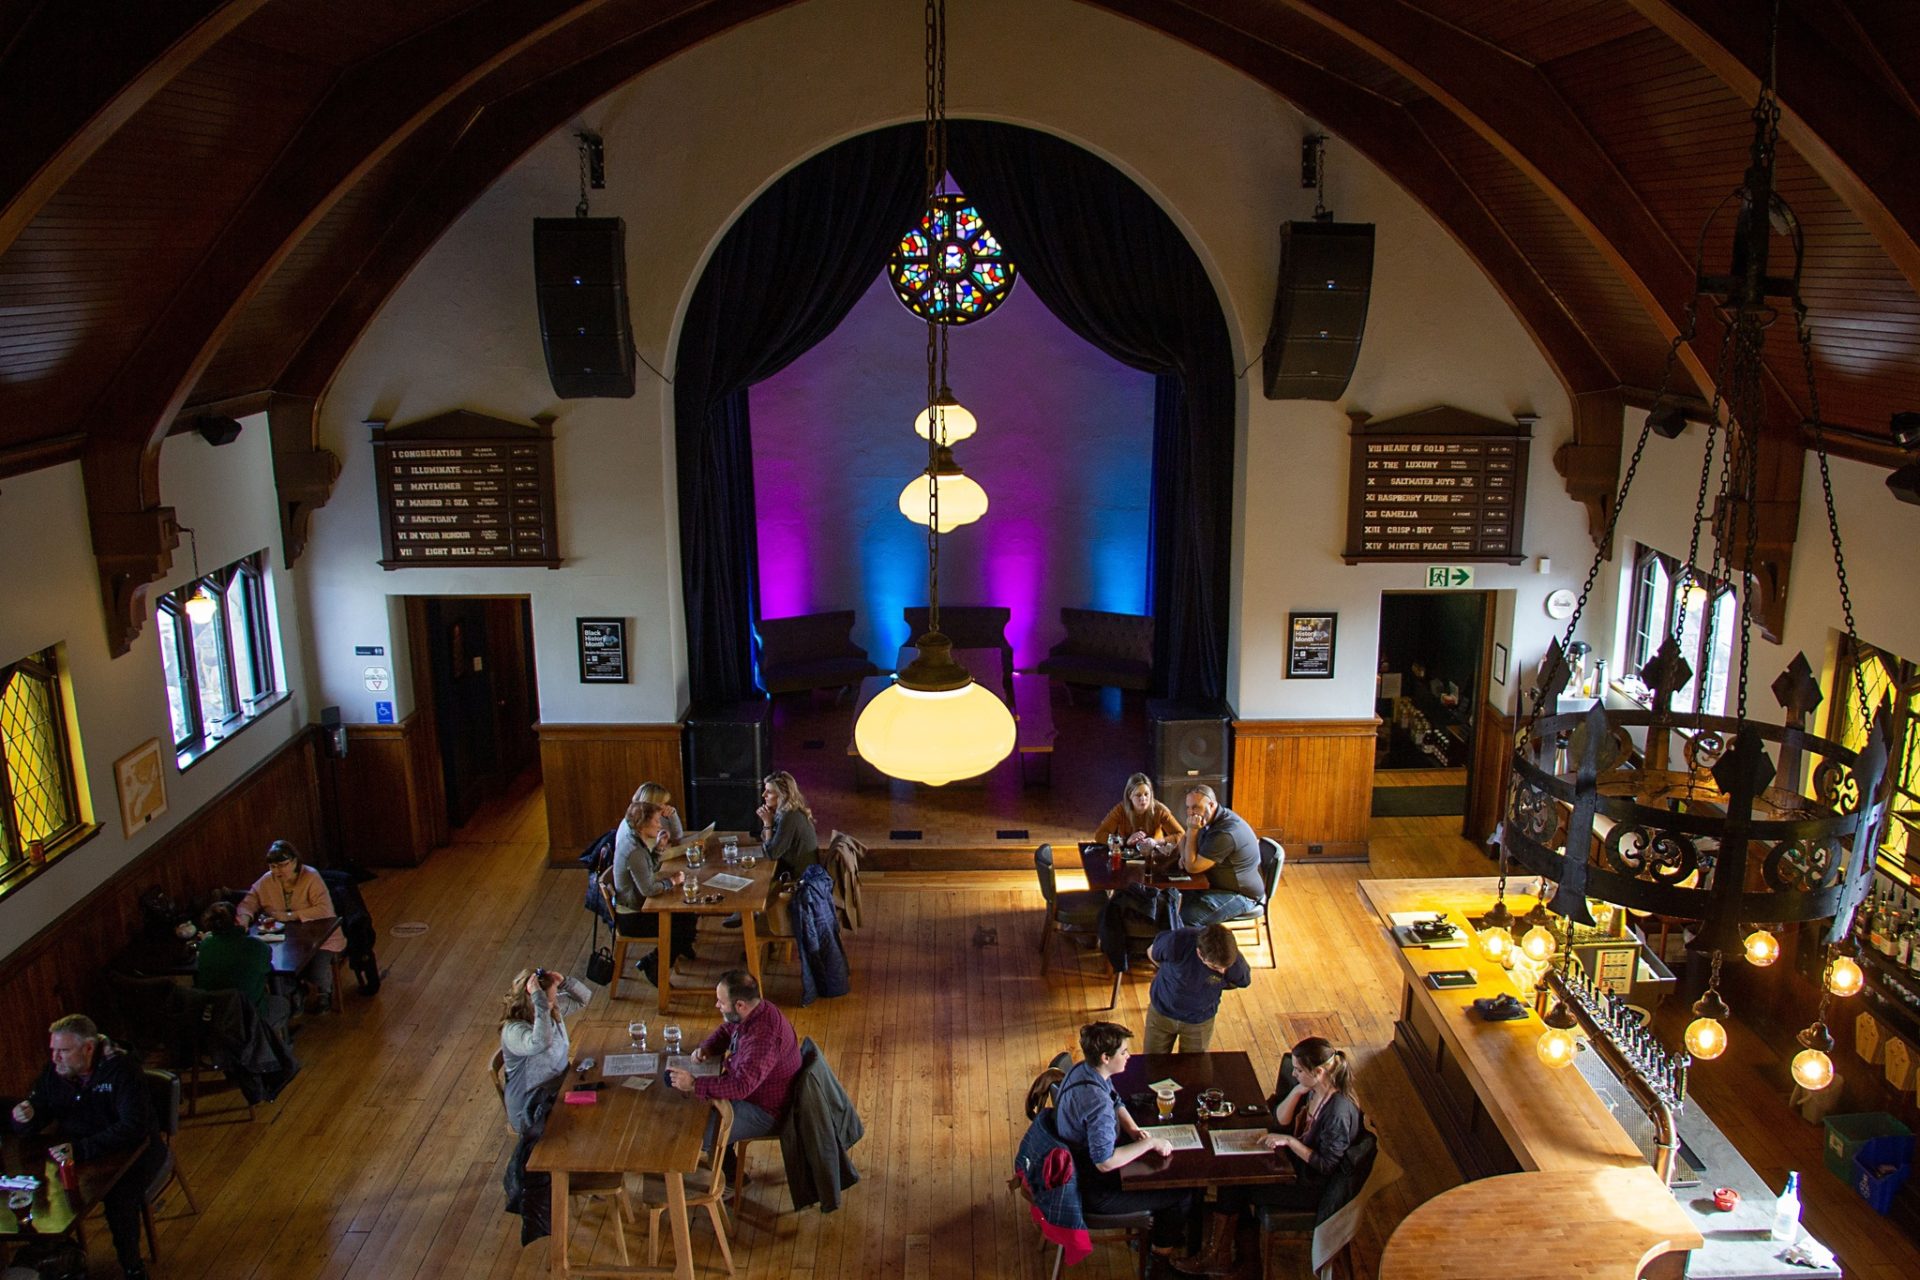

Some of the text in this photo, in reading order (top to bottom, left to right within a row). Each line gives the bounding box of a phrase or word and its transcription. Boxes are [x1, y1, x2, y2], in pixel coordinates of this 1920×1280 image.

[1383, 444, 1409, 452] HEART
[1411, 444, 1421, 452] OF
[1424, 444, 1445, 453] GOLD
[398, 450, 462, 458] CONGREGATION
[1383, 461, 1399, 469] THE
[1405, 461, 1439, 469] LUXURY
[411, 466, 461, 474] ILLUMINATE
[1435, 478, 1456, 486] JOYS
[1377, 494, 1422, 502] RASPBERRY
[409, 499, 442, 507] MARRIED
[411, 515, 458, 523] SANCTUARY
[1386, 526, 1411, 534] CRISP
[1416, 526, 1434, 534] DRY
[451, 547, 475, 555] BELLS
